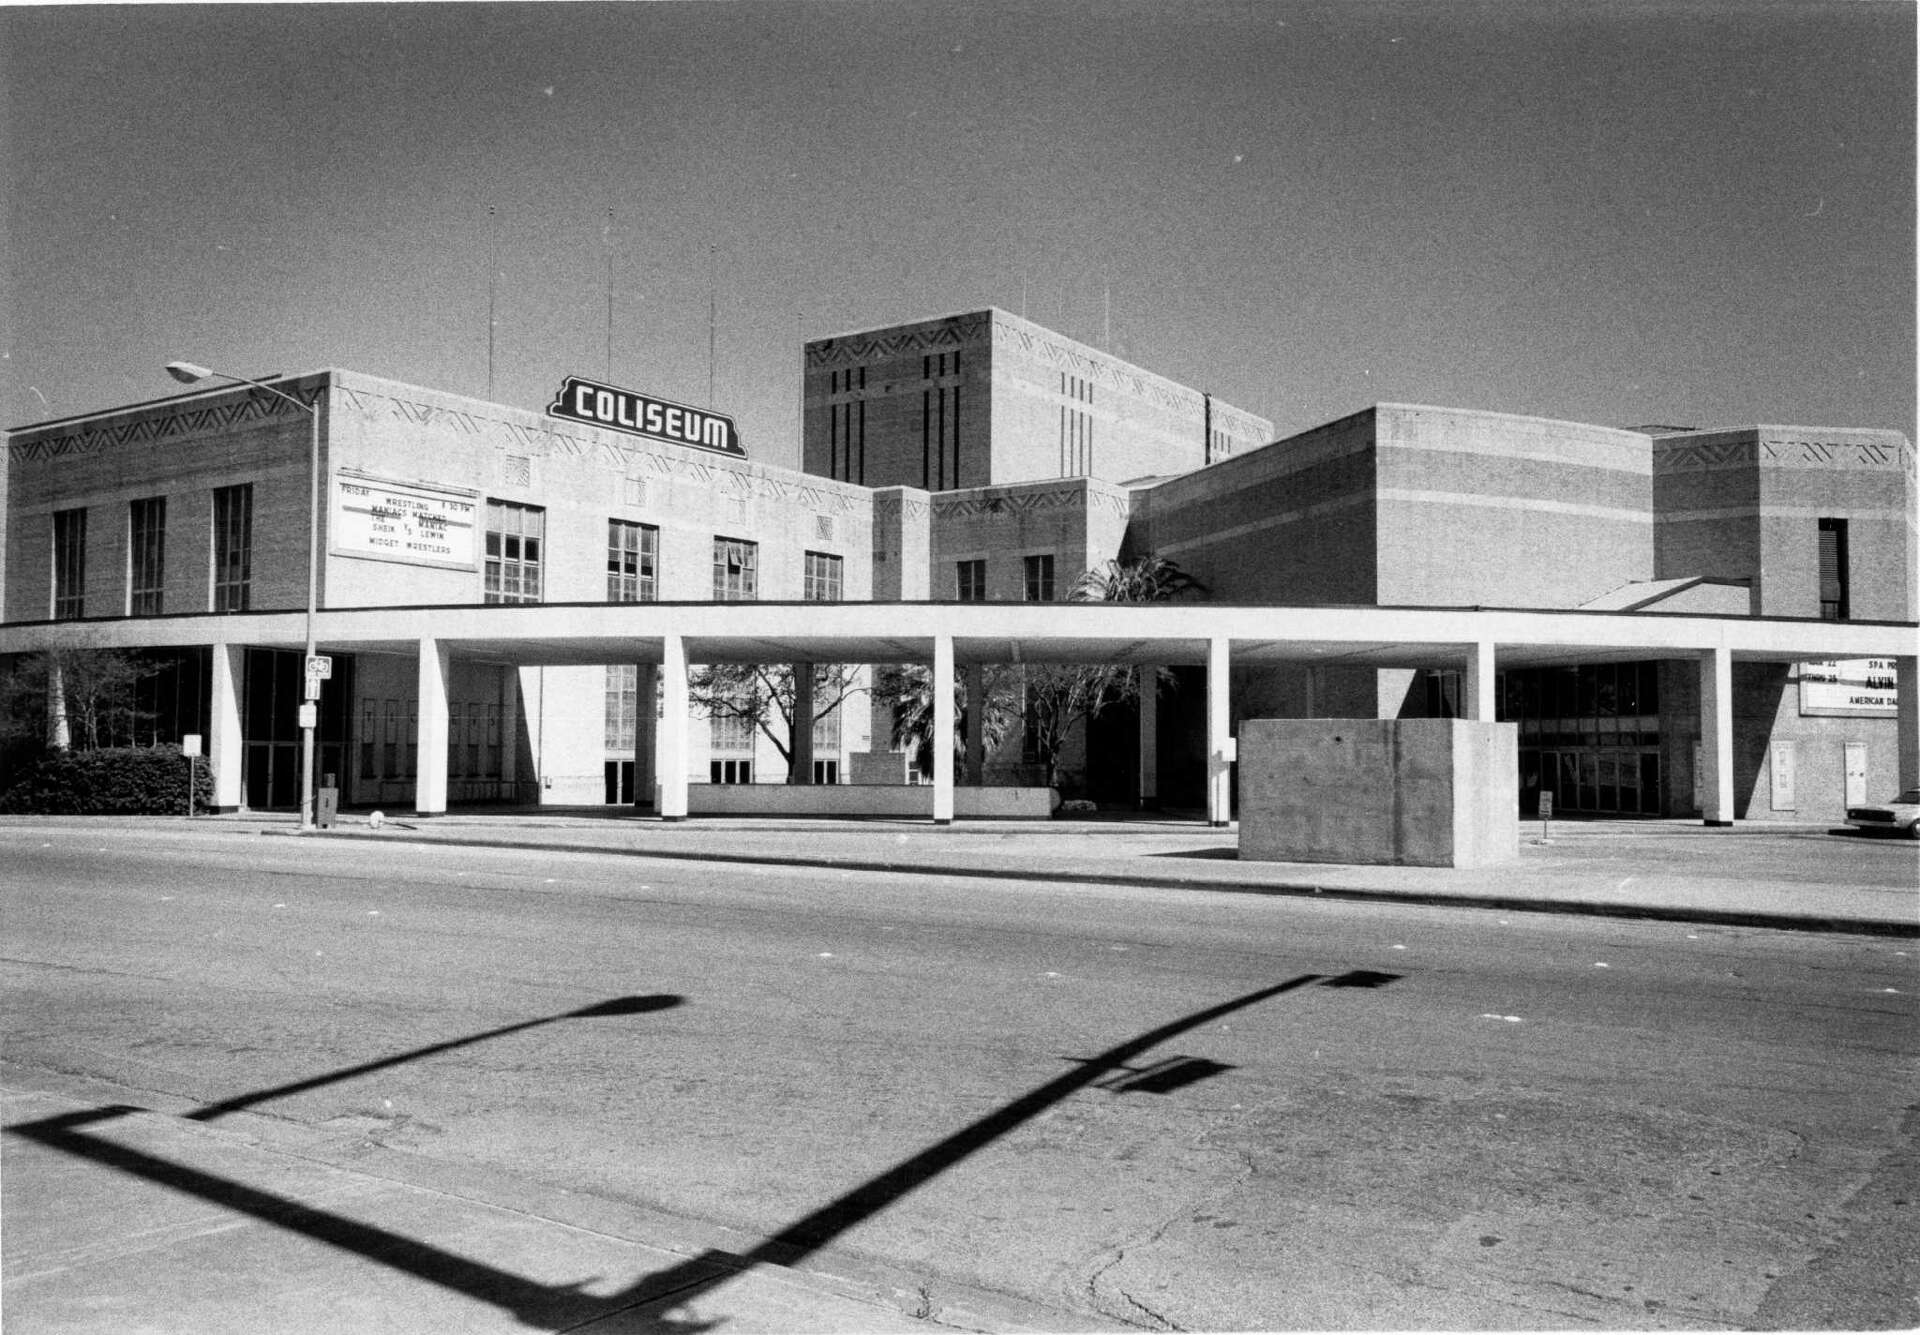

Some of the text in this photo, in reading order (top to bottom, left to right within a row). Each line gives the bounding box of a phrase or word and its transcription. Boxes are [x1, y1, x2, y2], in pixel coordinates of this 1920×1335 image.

[575, 385, 728, 448] COLISEUM
[341, 485, 370, 497] FRIDAY
[386, 498, 429, 511] WRESTLING
[373, 523, 395, 533] SHEIK
[421, 530, 445, 540] LEWIN
[369, 537, 452, 554] MIDGET WRESTLERS
[1869, 661, 1884, 669] SPA
[1866, 676, 1894, 689] ALVIN
[1849, 696, 1884, 705] AMERICAN
[367, 711, 495, 727] TICETS
